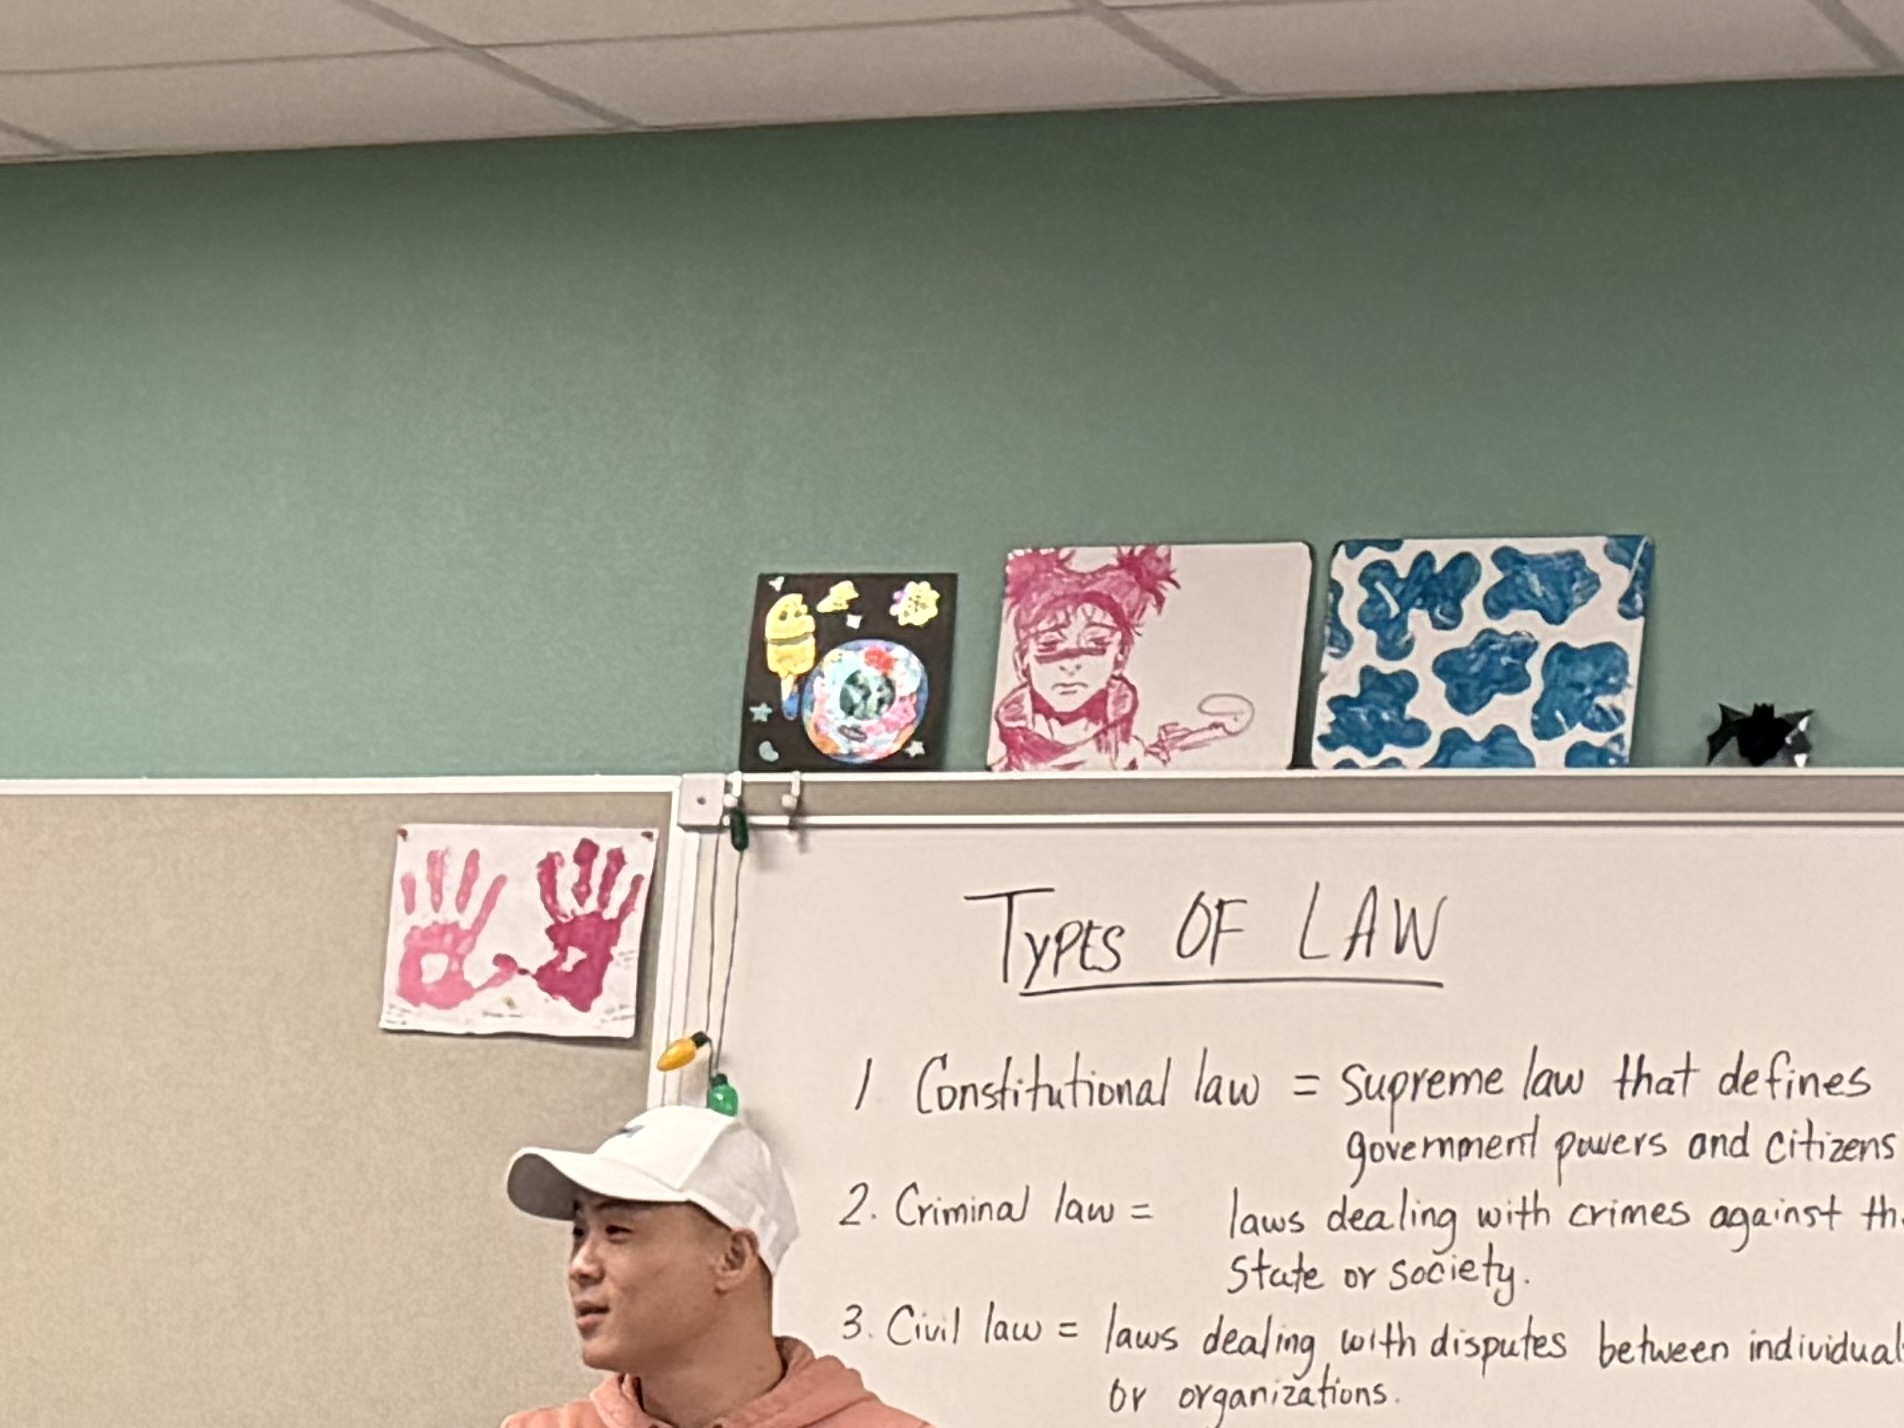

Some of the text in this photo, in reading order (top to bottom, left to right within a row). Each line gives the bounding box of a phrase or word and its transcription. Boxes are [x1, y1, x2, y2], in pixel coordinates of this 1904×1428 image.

[1176, 890, 1248, 966] OF
[1298, 881, 1449, 964] LAW
[916, 1051, 1172, 1115] Constitutional
[1195, 1047, 1261, 1107] law
[1523, 1045, 1585, 1100] law
[1614, 1051, 1700, 1101] that
[1718, 1049, 1873, 1101] defines
[1347, 1114, 1541, 1188] government
[1554, 1129, 1669, 1187] powers
[1688, 1120, 1751, 1162] and
[838, 1182, 878, 1227] 2.
[895, 1181, 1030, 1227] Criminal
[1054, 1181, 1115, 1225] law
[1229, 1187, 1306, 1240] laws
[1326, 1188, 1459, 1256] dealing
[1477, 1189, 1551, 1230] with
[1568, 1198, 1691, 1226] crimes
[1709, 1194, 1844, 1254] against
[1344, 1263, 1377, 1290] or
[842, 1304, 873, 1341] 3.
[887, 1304, 962, 1347] Civil
[984, 1301, 1042, 1343] law
[1105, 1302, 1179, 1355] laws
[1202, 1314, 1316, 1381] dealing
[1341, 1320, 1417, 1360] with
[1430, 1315, 1568, 1379] disputes
[1599, 1320, 1730, 1370] between
[1109, 1378, 1148, 1414] or
